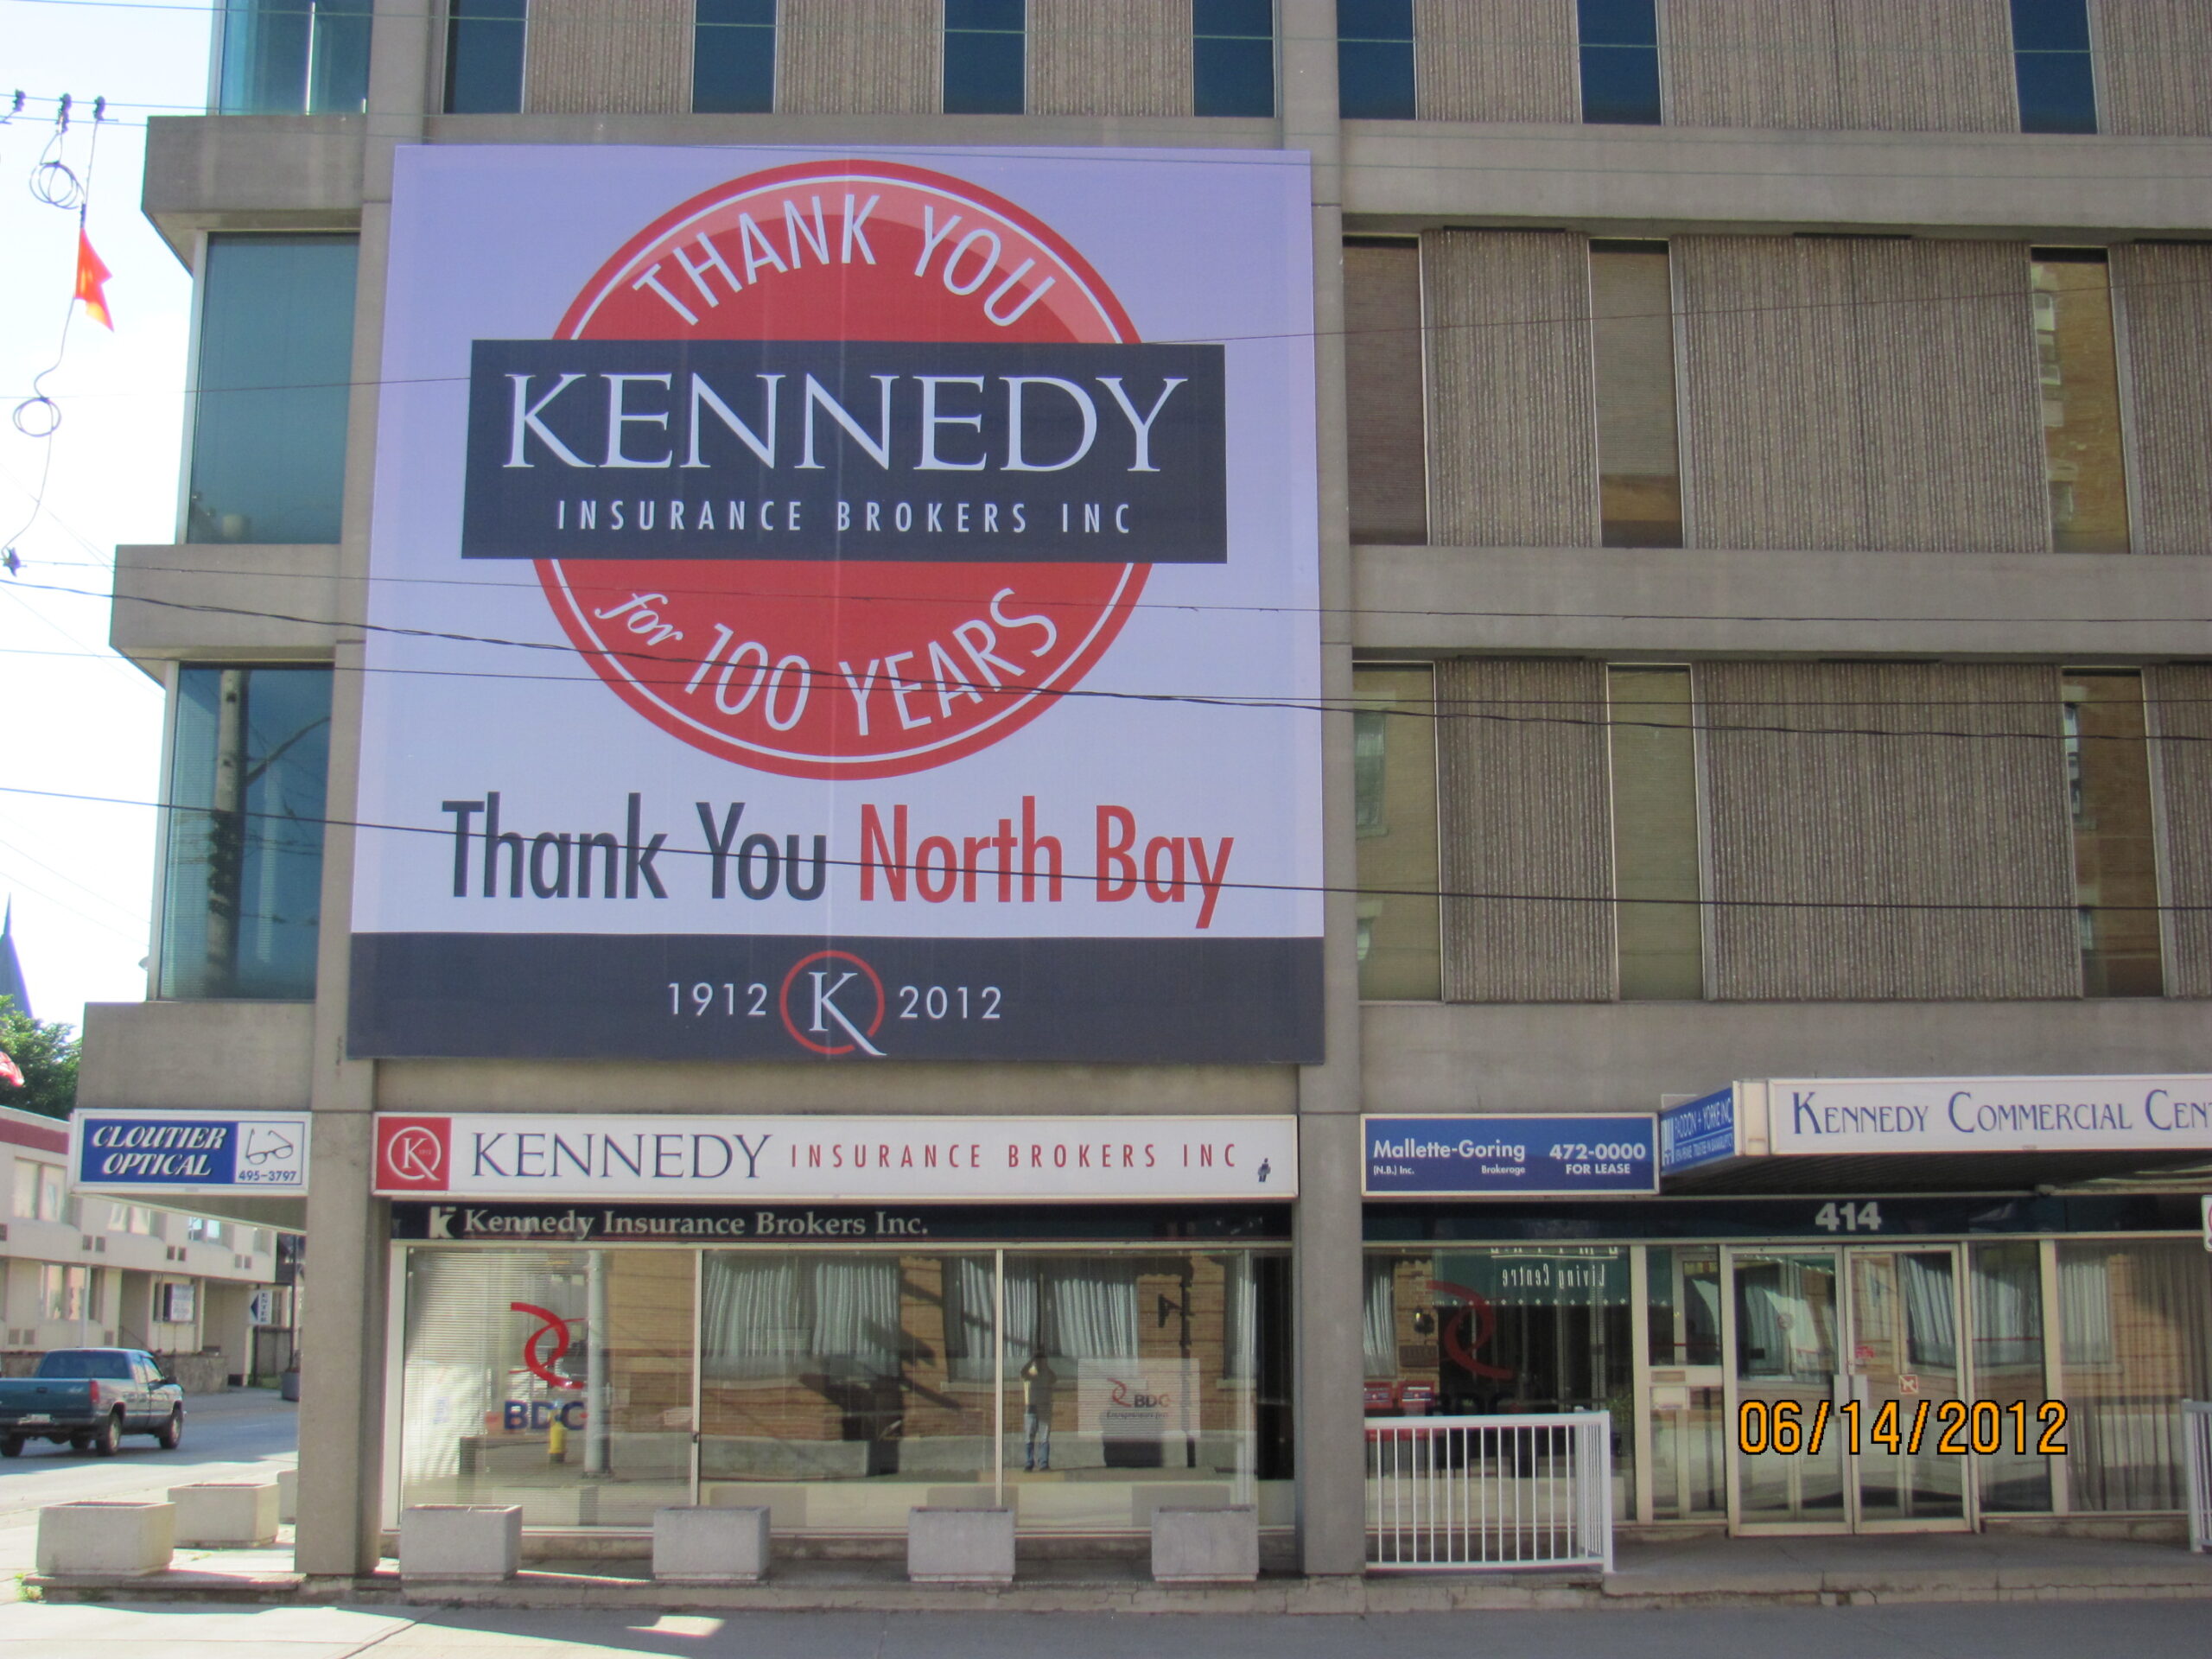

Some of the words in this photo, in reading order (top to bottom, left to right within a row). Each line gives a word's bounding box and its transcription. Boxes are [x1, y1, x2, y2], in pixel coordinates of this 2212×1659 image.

[632, 194, 880, 326] THANK
[914, 204, 1056, 327] YOU
[503, 372, 1189, 473] KENNEDY
[557, 499, 802, 531] INSURANCE
[837, 501, 1027, 533] BROKERS
[1061, 503, 1131, 534] INC
[594, 592, 683, 645] for
[684, 622, 811, 732] 100
[838, 587, 1058, 736] YEARS
[442, 791, 667, 899] Thank
[696, 801, 825, 900] You
[859, 795, 1063, 903] North
[1094, 804, 1233, 929] Bay
[668, 982, 767, 1018] 1912
[899, 985, 1002, 1020] 2012
[1791, 1091, 1929, 1135] KENNEDY
[1948, 1091, 2133, 1134] COMMERCIAL
[92, 1126, 227, 1149] CLOUTIER
[1374, 1138, 1526, 1162] Mallette-Goring
[1549, 1142, 1646, 1160] 472-0000
[103, 1153, 212, 1176] OPTICAL
[472, 1132, 773, 1179] KENNEDY
[791, 1144, 981, 1168] INSURANCE
[1008, 1144, 1156, 1169] BROKERS
[1183, 1143, 1236, 1168] INC
[1400, 1165, 1415, 1175] Inc.
[1481, 1164, 1526, 1176] Brokerage
[1567, 1164, 1592, 1174] FOR
[1595, 1164, 1630, 1174] LEASE
[238, 1170, 296, 1181] 495-3797
[463, 1209, 594, 1241] Kennedy
[603, 1211, 746, 1235] Insurance
[755, 1211, 866, 1235] Brokers
[874, 1211, 929, 1236] Inc.
[1815, 1201, 1882, 1231] 414
[504, 1400, 586, 1431] BDC
[1134, 1393, 1170, 1408] BDC
